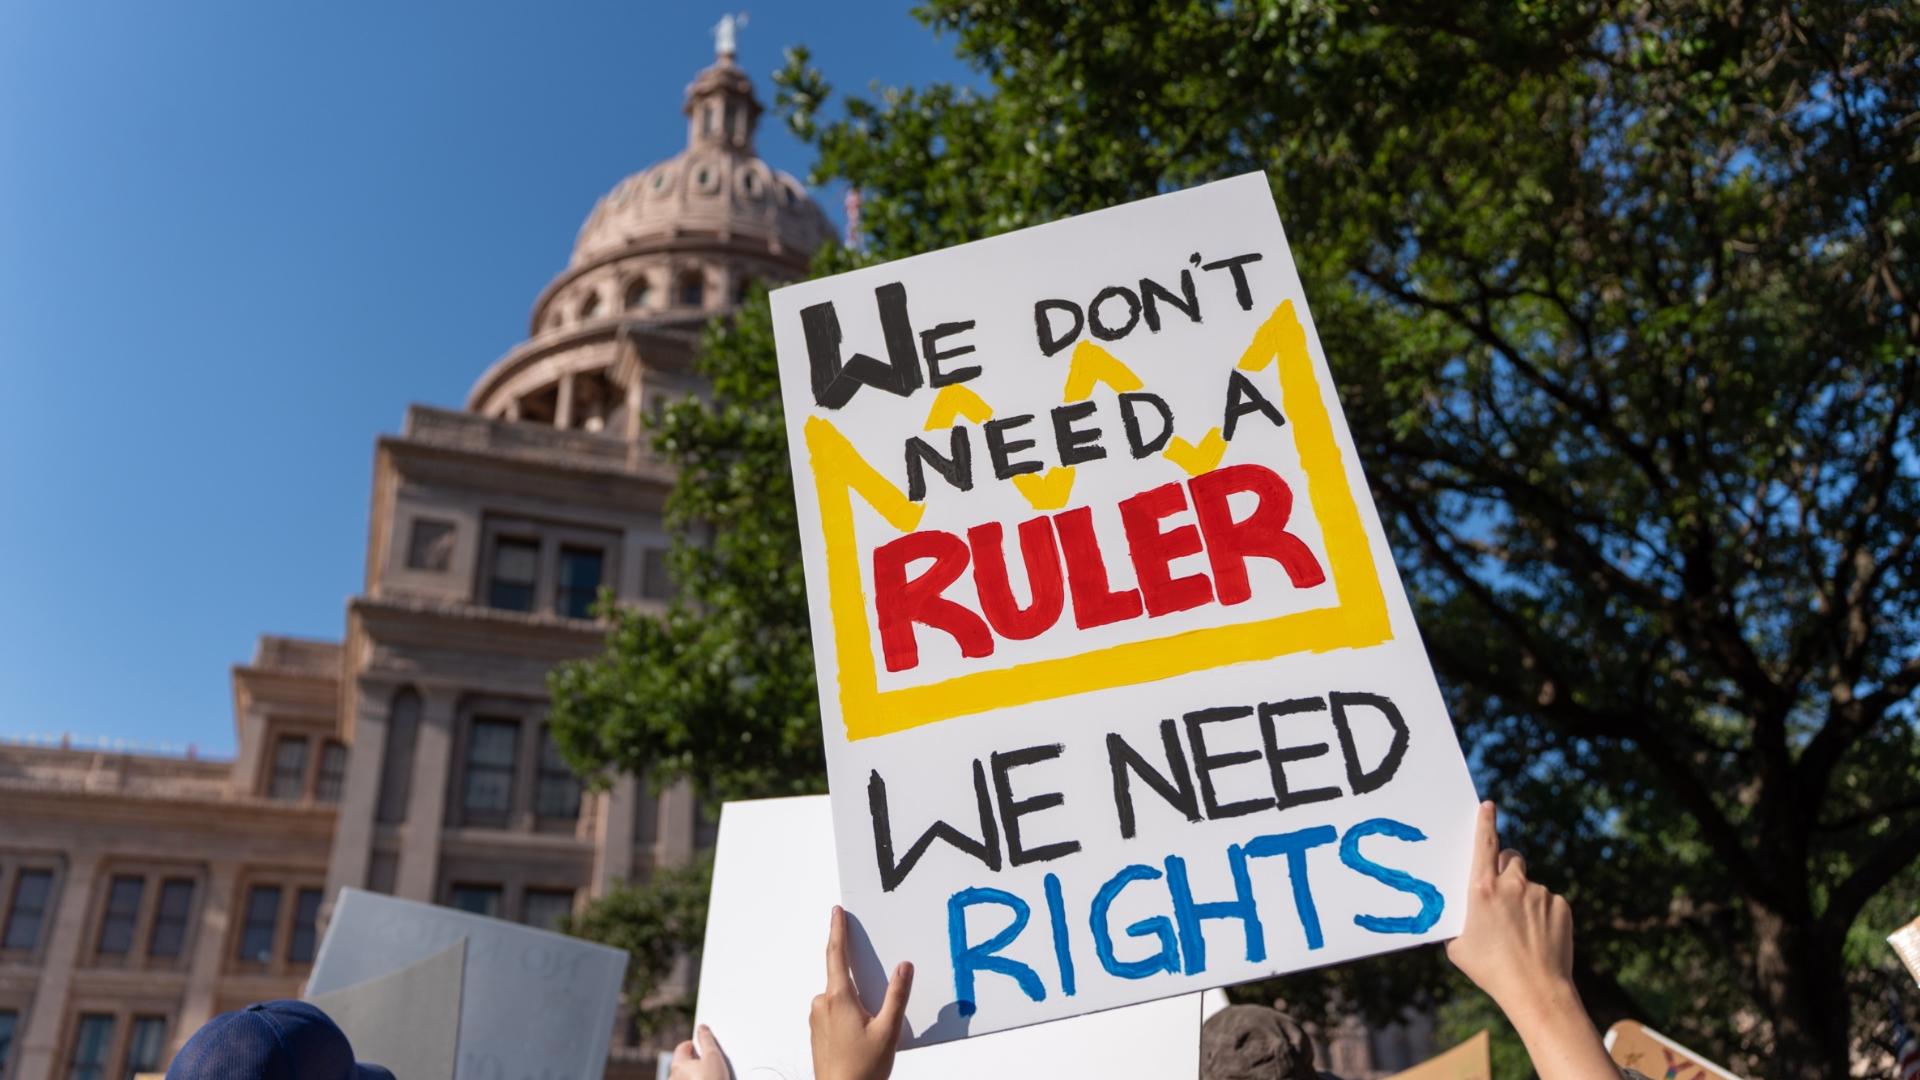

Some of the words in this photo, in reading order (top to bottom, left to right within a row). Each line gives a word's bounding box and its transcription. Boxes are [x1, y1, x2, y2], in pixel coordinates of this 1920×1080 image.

[799, 282, 983, 410] WE
[1034, 252, 1263, 357] DON'T
[904, 393, 1175, 501] NEED
[1222, 369, 1286, 442] A
[873, 463, 1326, 673] RULER
[867, 744, 1082, 892] WE
[1105, 691, 1410, 839] NEED
[947, 818, 1445, 1019] RIGHTS
